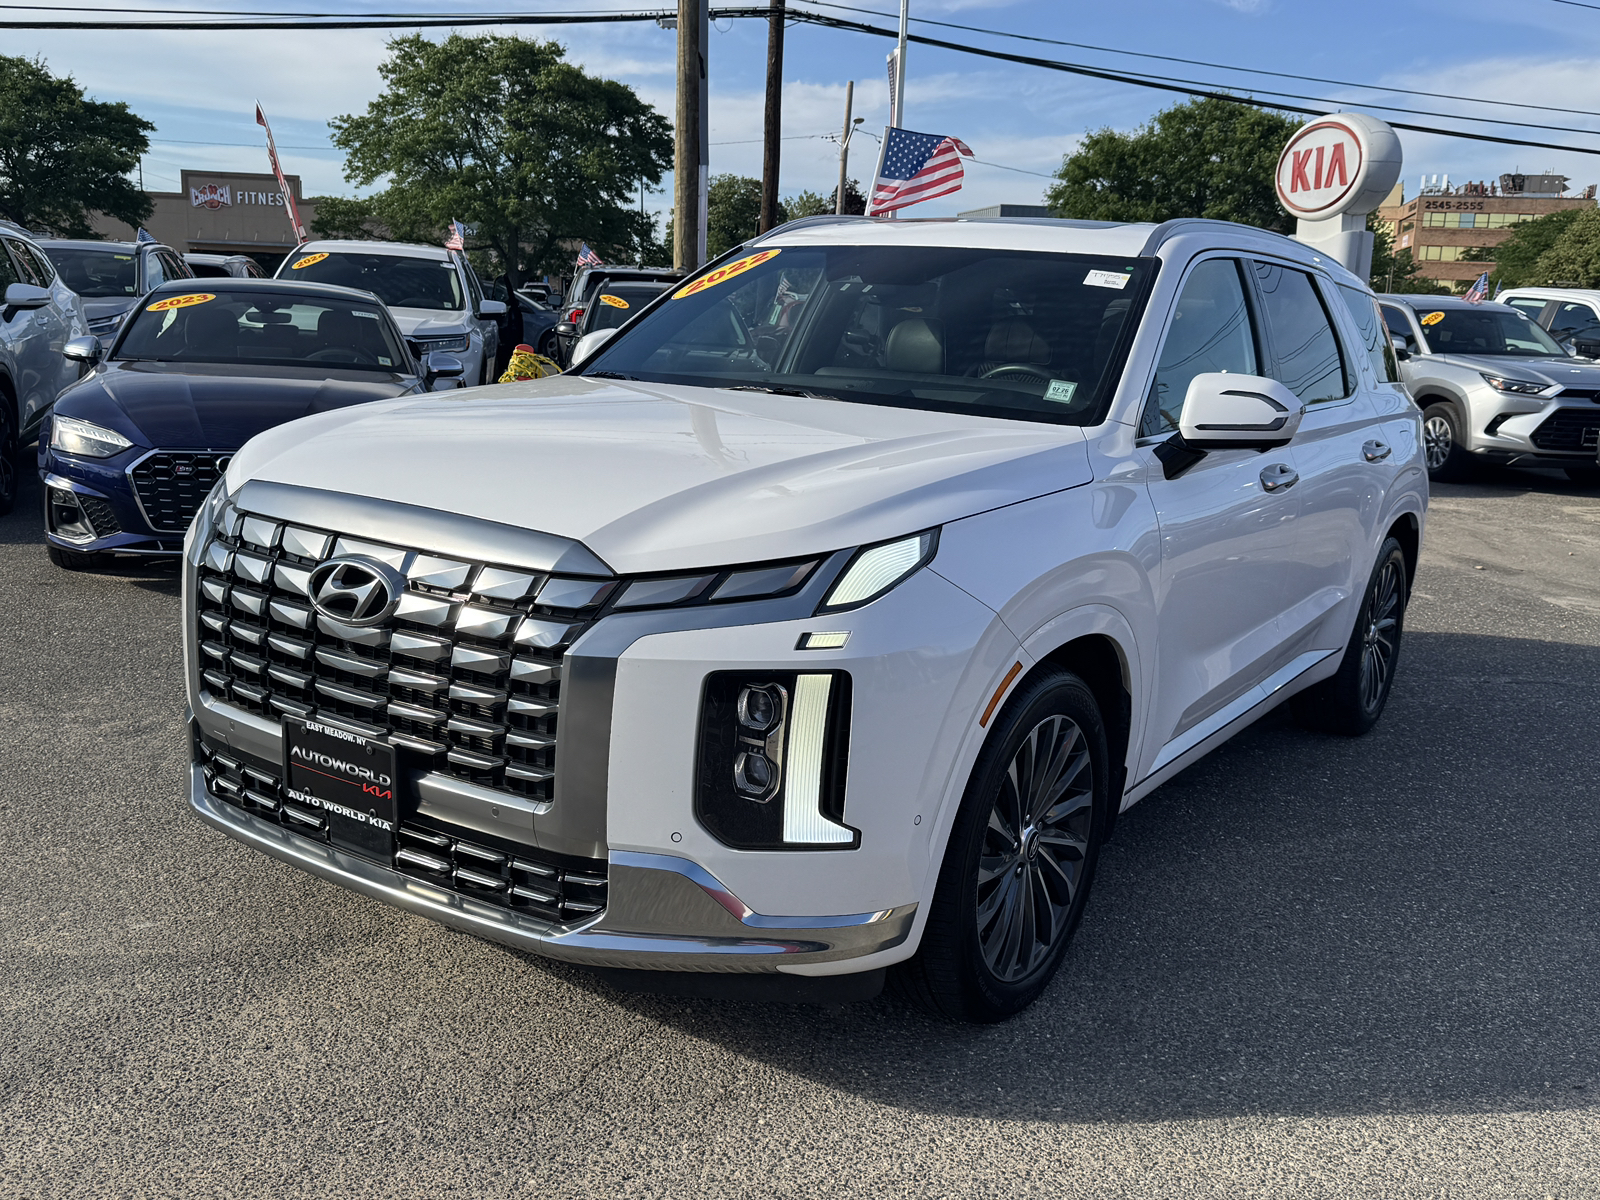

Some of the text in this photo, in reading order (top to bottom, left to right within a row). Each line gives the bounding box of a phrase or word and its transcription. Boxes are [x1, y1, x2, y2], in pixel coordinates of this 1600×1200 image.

[1290, 142, 1348, 193] KIA
[190, 184, 290, 207] CRUNCH FITNES
[1425, 201, 1484, 210] 2545-2555
[296, 253, 326, 268] 2024
[685, 251, 770, 296] 2022
[155, 294, 209, 310] 2023
[306, 721, 323, 733] EAST
[356, 735, 367, 747] NY
[290, 745, 391, 787] AUTOWORLD
[362, 782, 393, 800] KIA
[287, 789, 392, 832] AUTO WORLD KIA
